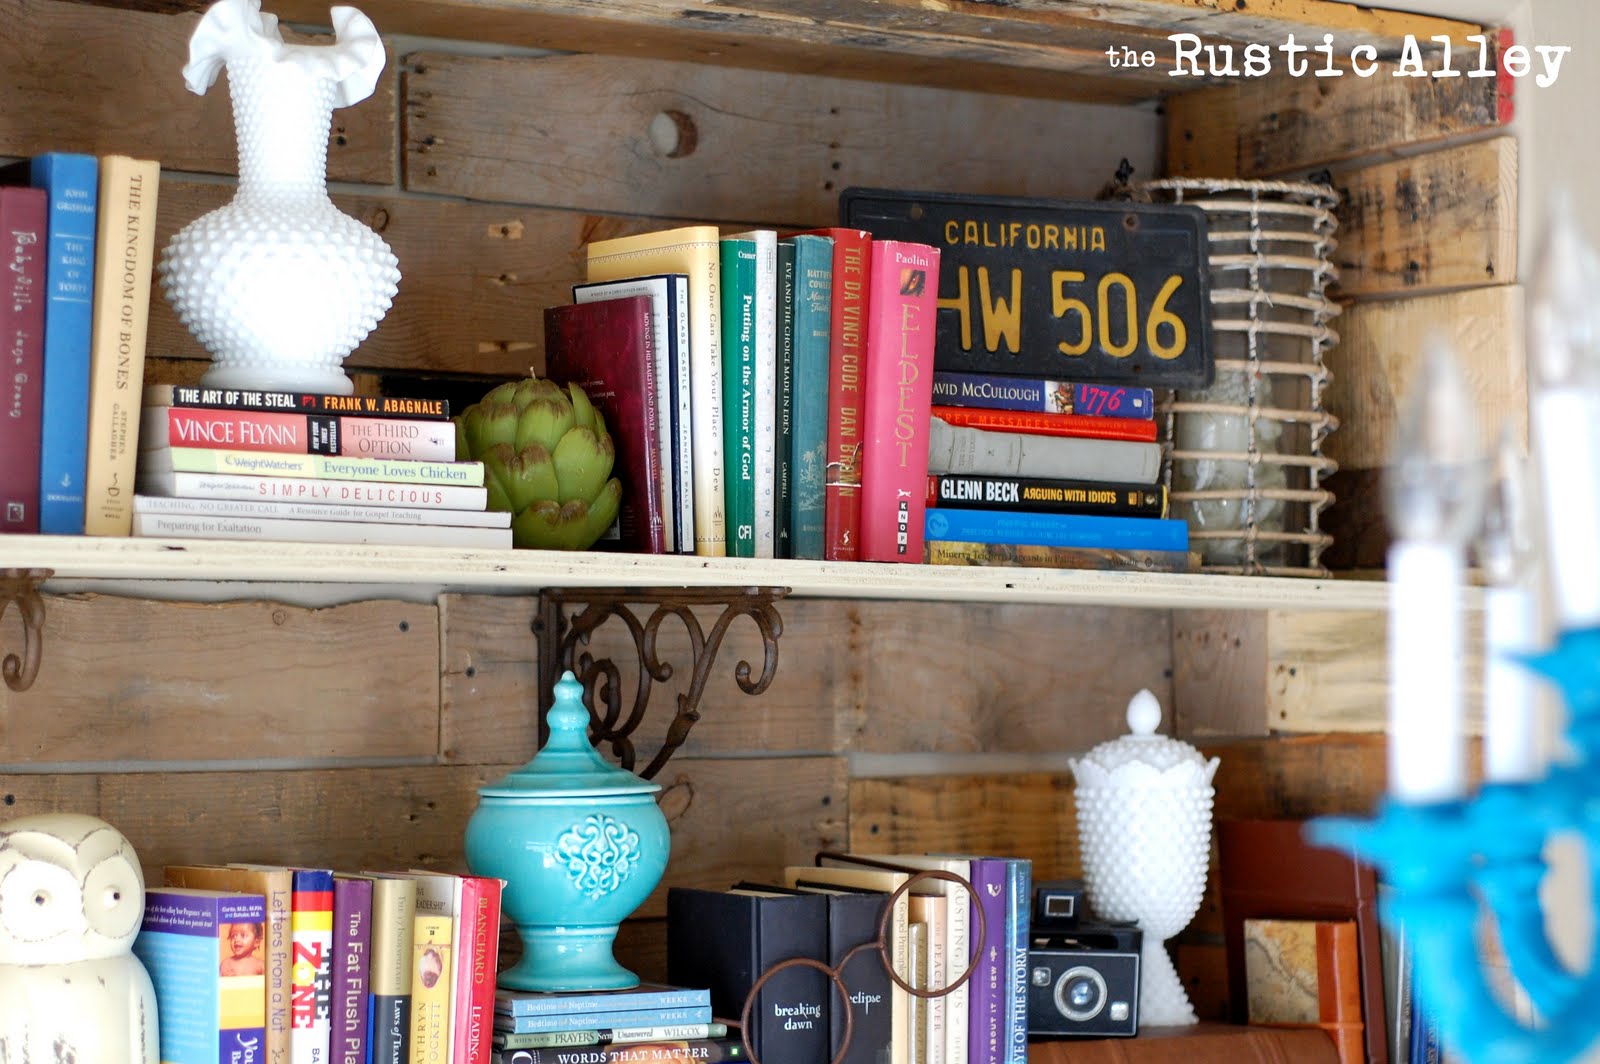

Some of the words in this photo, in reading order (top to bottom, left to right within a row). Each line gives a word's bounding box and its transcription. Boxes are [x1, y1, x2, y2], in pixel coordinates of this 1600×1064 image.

[129, 174, 142, 210] THE
[945, 220, 1106, 251] CALIFORNIA
[122, 214, 139, 300] KINGDOM
[845, 247, 861, 274] THE
[896, 252, 929, 267] Paolini
[708, 262, 716, 279] No
[709, 283, 717, 309] One
[844, 281, 861, 300] DA
[121, 304, 134, 328] OF
[709, 313, 717, 336] Can
[740, 294, 753, 343] Putting
[784, 304, 792, 325] THE
[843, 306, 860, 347] VINCI
[1052, 270, 1187, 360] 506
[116, 332, 132, 390] BONES
[710, 340, 718, 367] Take
[742, 345, 751, 362] on
[742, 365, 752, 386] the
[842, 354, 859, 392] CODE
[895, 303, 921, 467] ELDEST
[179, 389, 199, 403] THE
[202, 390, 224, 405] ART
[225, 391, 239, 405] OF
[241, 392, 262, 406] THE
[264, 393, 296, 408] STEAL
[711, 371, 719, 401] Your
[933, 382, 957, 395] AVID
[1081, 383, 1127, 414] 1776
[324, 396, 362, 411] FRANK
[366, 398, 380, 412] W.
[384, 399, 443, 415] ABAGNALE
[742, 388, 751, 433] Armor
[783, 395, 790, 407] IN
[109, 402, 120, 461] GALLAGHER
[119, 410, 127, 455] STEPHEN
[174, 417, 234, 444] VINCE
[239, 420, 297, 447] FLYNN
[350, 424, 372, 437] THE
[373, 422, 419, 439] THIRD
[840, 407, 856, 437] DAN
[978, 415, 1051, 429] MESSAGES
[312, 436, 320, 450] NEW
[329, 421, 337, 453] BESTSELLER
[358, 438, 412, 454] OPTION
[742, 435, 752, 450] of
[323, 461, 380, 479] Everyone
[383, 463, 416, 478] Loves
[420, 465, 468, 480] Chicken
[742, 452, 752, 480] God
[259, 482, 331, 498] SIMPLY
[341, 486, 443, 504] DELICIOUS
[712, 468, 721, 493] Dew
[941, 479, 982, 500] GLENN
[986, 481, 1020, 502] BECK
[1023, 487, 1063, 502] ARGUING
[1065, 488, 1087, 503] WITH
[1088, 489, 1117, 504] IDIOTS
[200, 501, 214, 511] NO
[353, 509, 363, 517] for
[365, 510, 390, 519] Gospel
[392, 511, 422, 520] Teaching
[157, 520, 200, 532] Preparing
[202, 521, 215, 531] for
[217, 522, 262, 533] Exaltation
[899, 502, 908, 553] KNOPF
[271, 890, 288, 948] Letters
[349, 911, 361, 936] The
[896, 901, 908, 933] Gospel
[475, 896, 488, 985] BLANCHARD
[347, 942, 363, 972] Fat
[896, 936, 907, 978] Principles
[271, 952, 288, 989] from
[1015, 947, 1027, 994] STORM
[292, 941, 321, 1029] ZONE
[314, 947, 332, 1020] THE
[934, 943, 942, 1031] PEACEIVER
[271, 993, 282, 1003] a
[345, 977, 362, 1031] Flush
[527, 1002, 557, 1011] Bedtime
[569, 1000, 598, 1009] Naptime
[660, 996, 688, 1004] WEEKS
[775, 1003, 821, 1018] breaking
[990, 1002, 997, 1013] IT
[1014, 994, 1026, 1022] THE
[271, 1007, 287, 1032] Nut
[394, 999, 403, 1026] LAWS
[528, 1019, 557, 1028] Bedtime
[569, 1017, 598, 1026] Naptime
[660, 1012, 687, 1020] WEEKS
[784, 1018, 812, 1030] dawn
[390, 1026, 402, 1039] of
[469, 1005, 482, 1061] LEADING
[554, 1032, 595, 1044] PRAYERS
[597, 1031, 613, 1040] Seem
[618, 1028, 654, 1039] Unanswered
[663, 1026, 701, 1037] WILCOX
[1014, 1022, 1025, 1043] OF
[557, 1051, 607, 1064] WORDS
[610, 1050, 648, 1061] THAT
[652, 1047, 709, 1060] MATTER
[1014, 1043, 1025, 1064] YE
